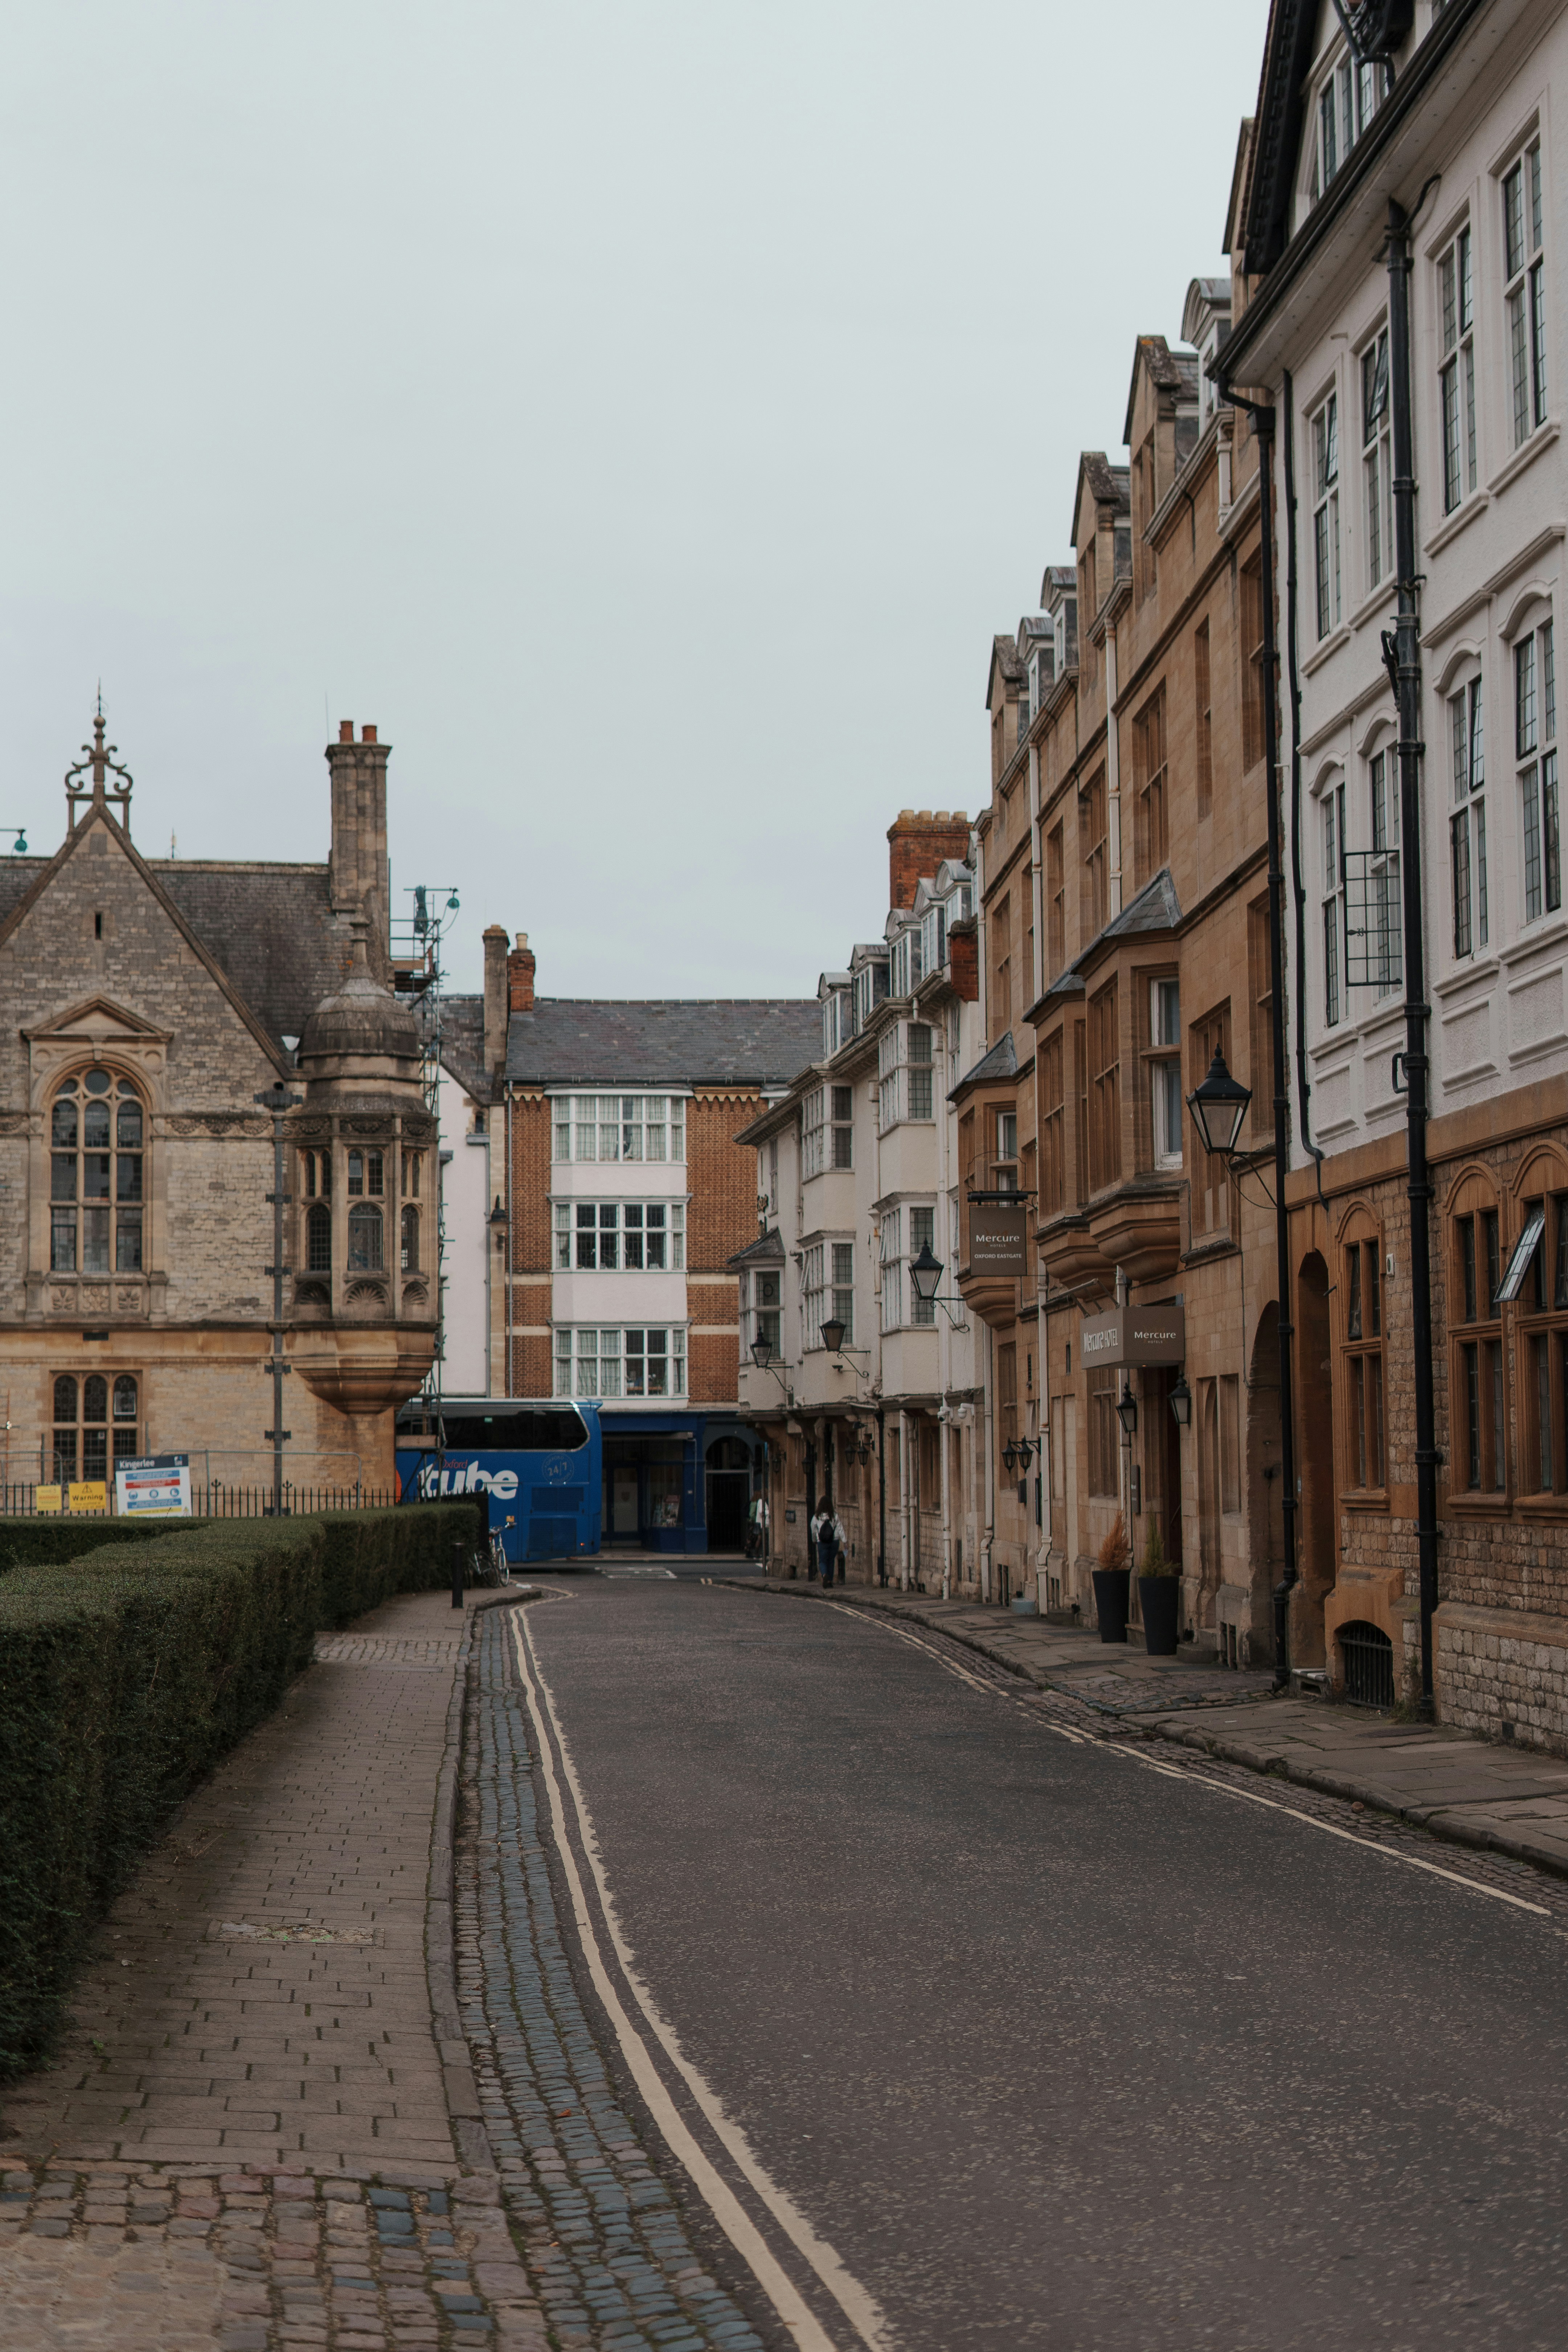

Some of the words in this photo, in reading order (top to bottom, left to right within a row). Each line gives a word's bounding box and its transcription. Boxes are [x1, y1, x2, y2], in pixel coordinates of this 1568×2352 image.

[1084, 1331, 1104, 1353] Mercure
[1104, 1328, 1118, 1348] HOTEL
[119, 1458, 155, 1470] Kingerlee
[417, 1460, 518, 1499] tube
